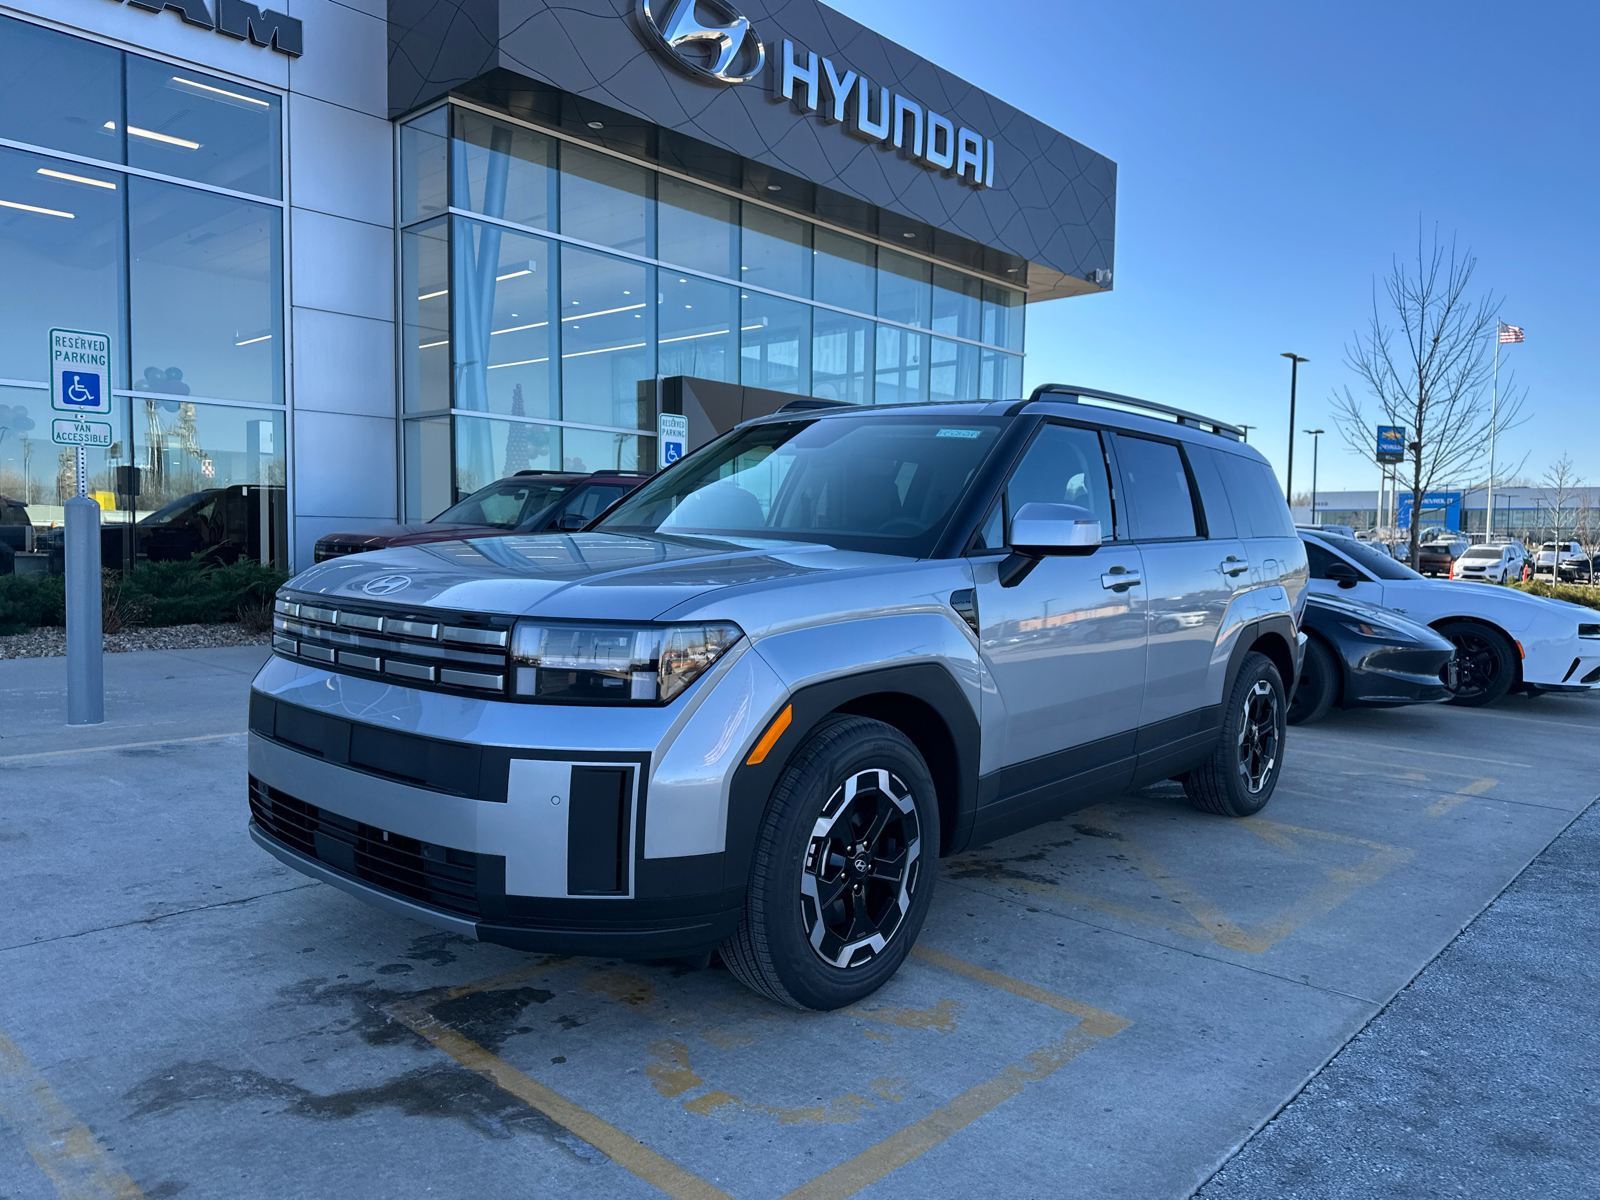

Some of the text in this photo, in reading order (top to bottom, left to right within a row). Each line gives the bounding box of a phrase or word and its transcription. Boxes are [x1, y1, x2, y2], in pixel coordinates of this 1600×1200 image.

[775, 38, 995, 189] HYUNDAI
[55, 335, 105, 352] RESERVED
[55, 350, 106, 366] PARKING
[74, 423, 91, 433] VAN
[662, 418, 685, 429] RESERVED
[55, 432, 109, 444] ACCESSIBLE
[662, 428, 685, 438] PARKING
